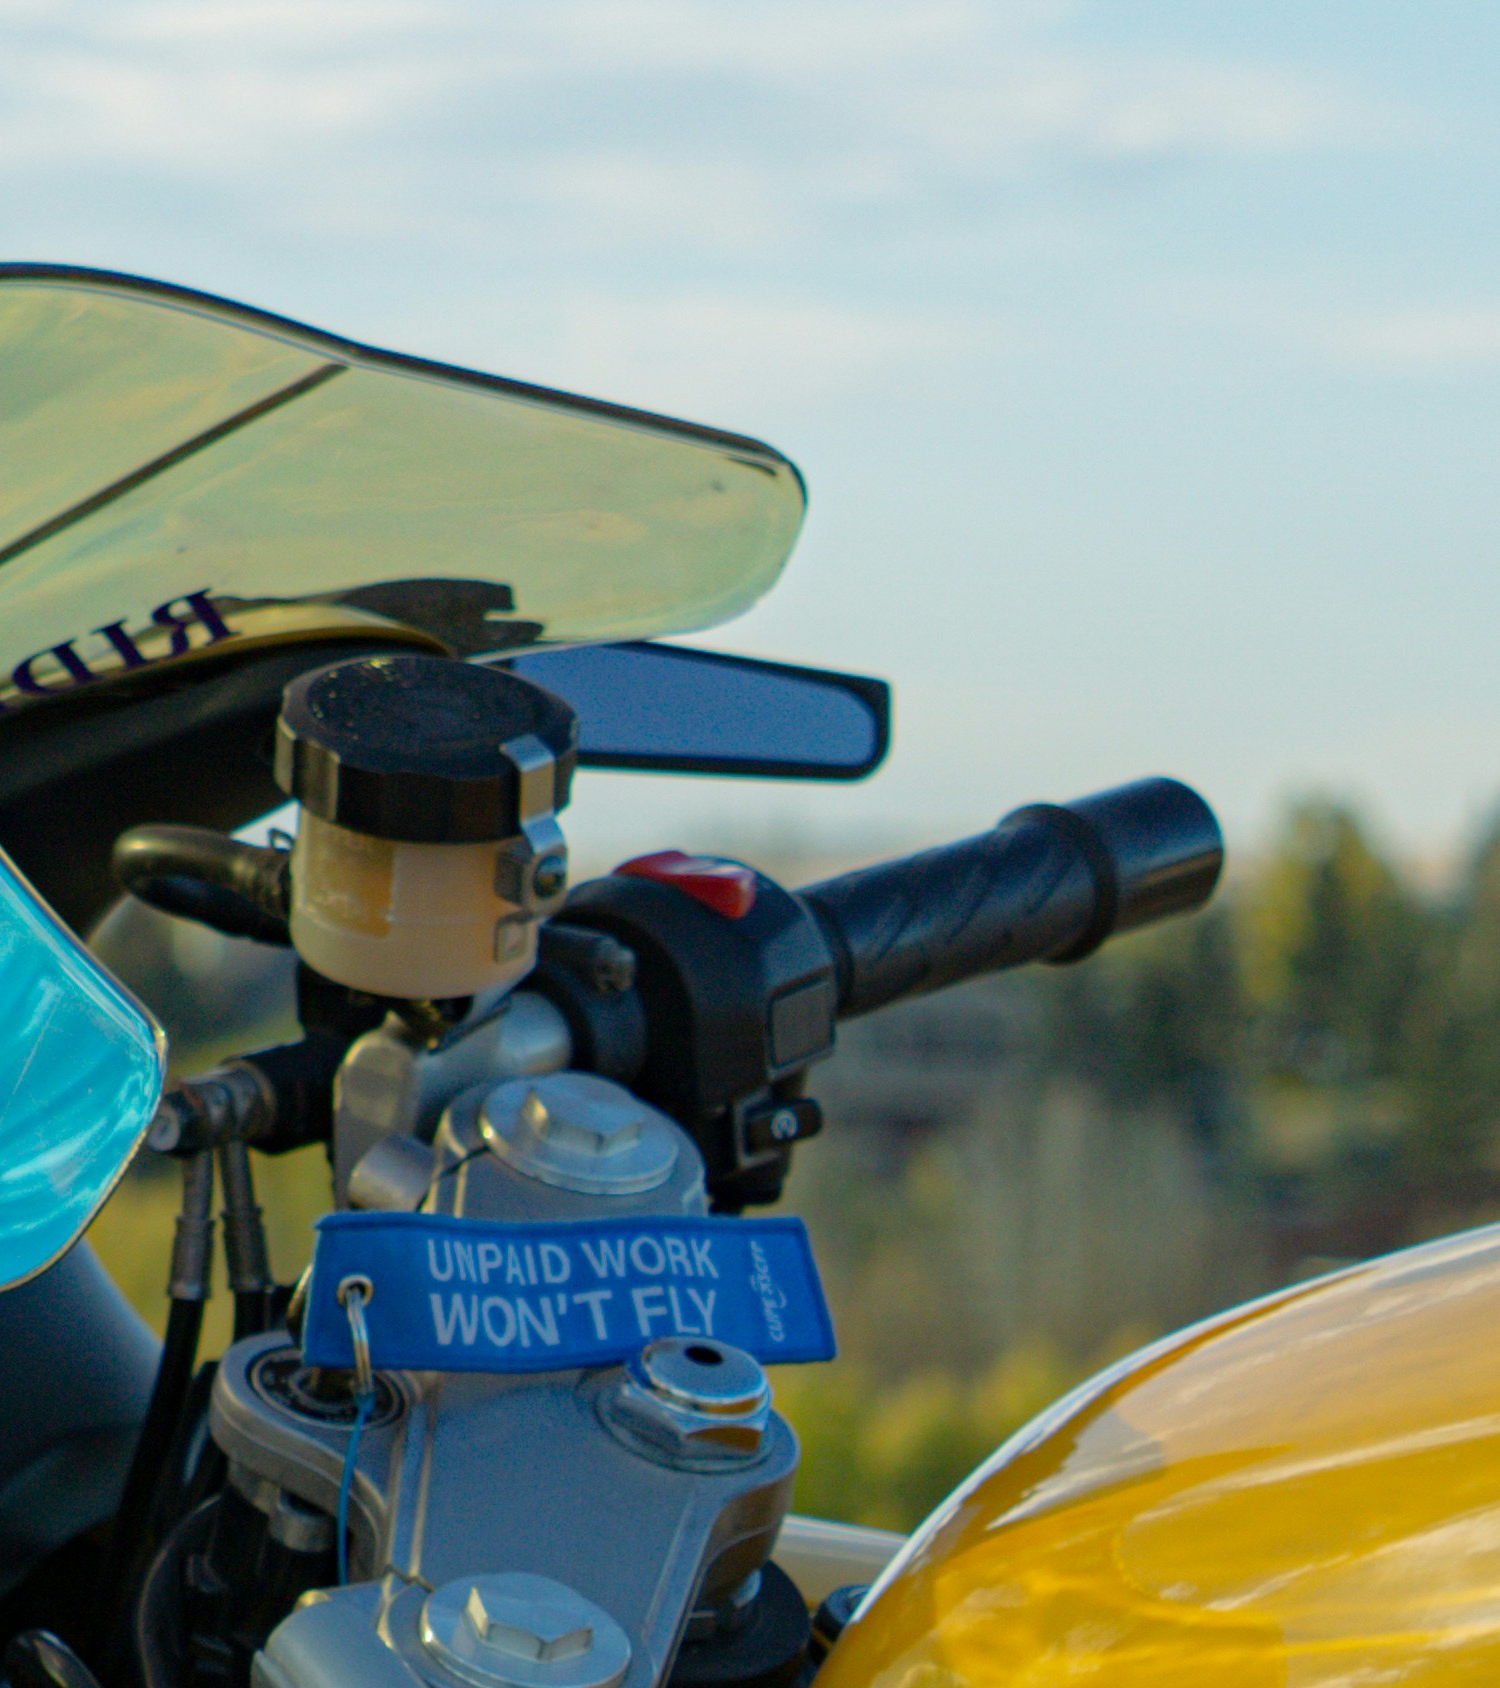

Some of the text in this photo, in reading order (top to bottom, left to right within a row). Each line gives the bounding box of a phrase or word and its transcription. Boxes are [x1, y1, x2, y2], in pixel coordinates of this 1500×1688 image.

[427, 1235, 720, 1285] UNPAID WORK
[428, 1285, 717, 1349] WON'T FLY
